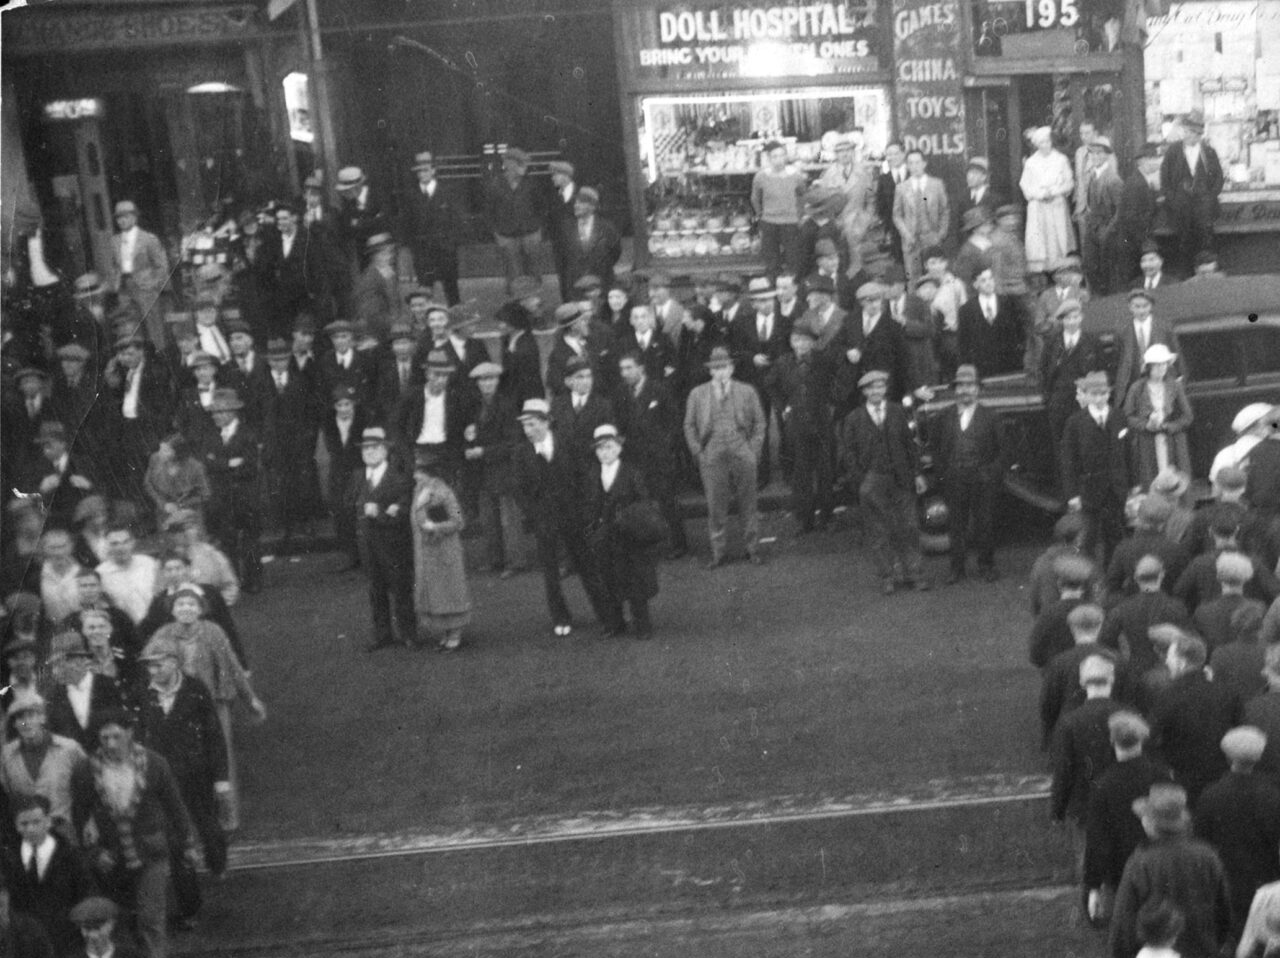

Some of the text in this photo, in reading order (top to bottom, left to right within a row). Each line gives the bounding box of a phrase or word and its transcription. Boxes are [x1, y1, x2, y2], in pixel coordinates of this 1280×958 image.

[660, 3, 855, 43] DOLL HOSPITAL
[895, 4, 956, 41] GAMES
[1026, 0, 1081, 28] 195
[640, 46, 693, 67] BRING
[694, 44, 744, 64] YOUR
[818, 39, 870, 59] ONES
[899, 58, 956, 82] CHINA
[907, 96, 959, 119] TOYS
[904, 133, 964, 156] DOLLS
